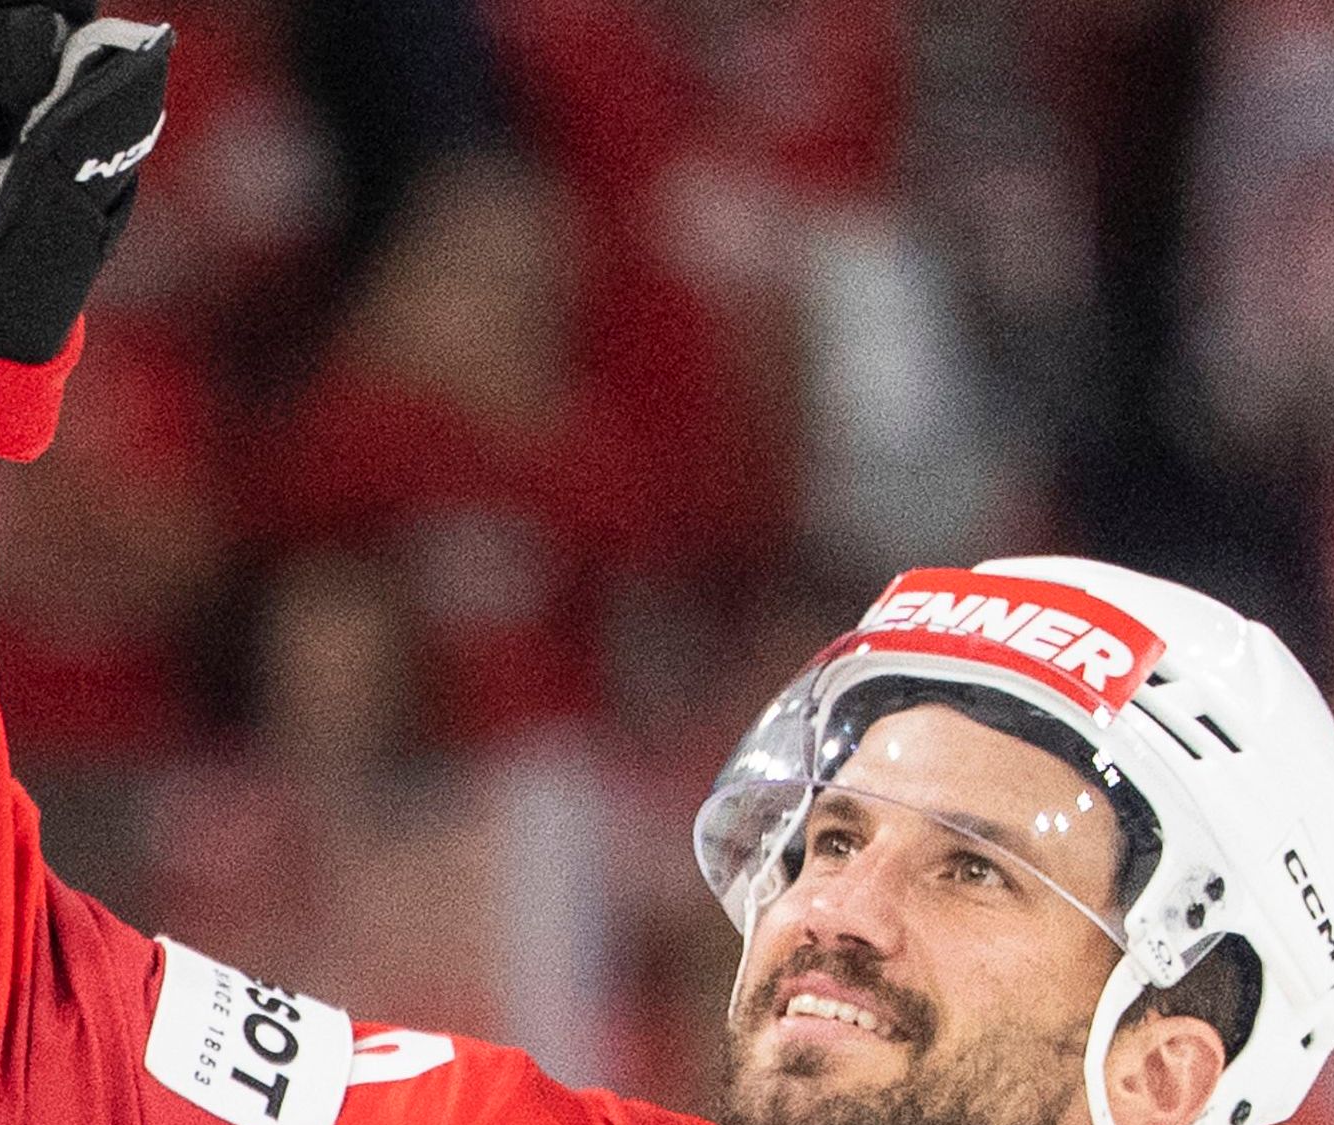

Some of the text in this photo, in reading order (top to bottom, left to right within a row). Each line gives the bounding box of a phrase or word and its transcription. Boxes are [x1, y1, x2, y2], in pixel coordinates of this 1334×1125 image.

[859, 591, 1135, 693] ENNER
[193, 1025, 226, 1087] 1853
[230, 979, 301, 1121] SOT
